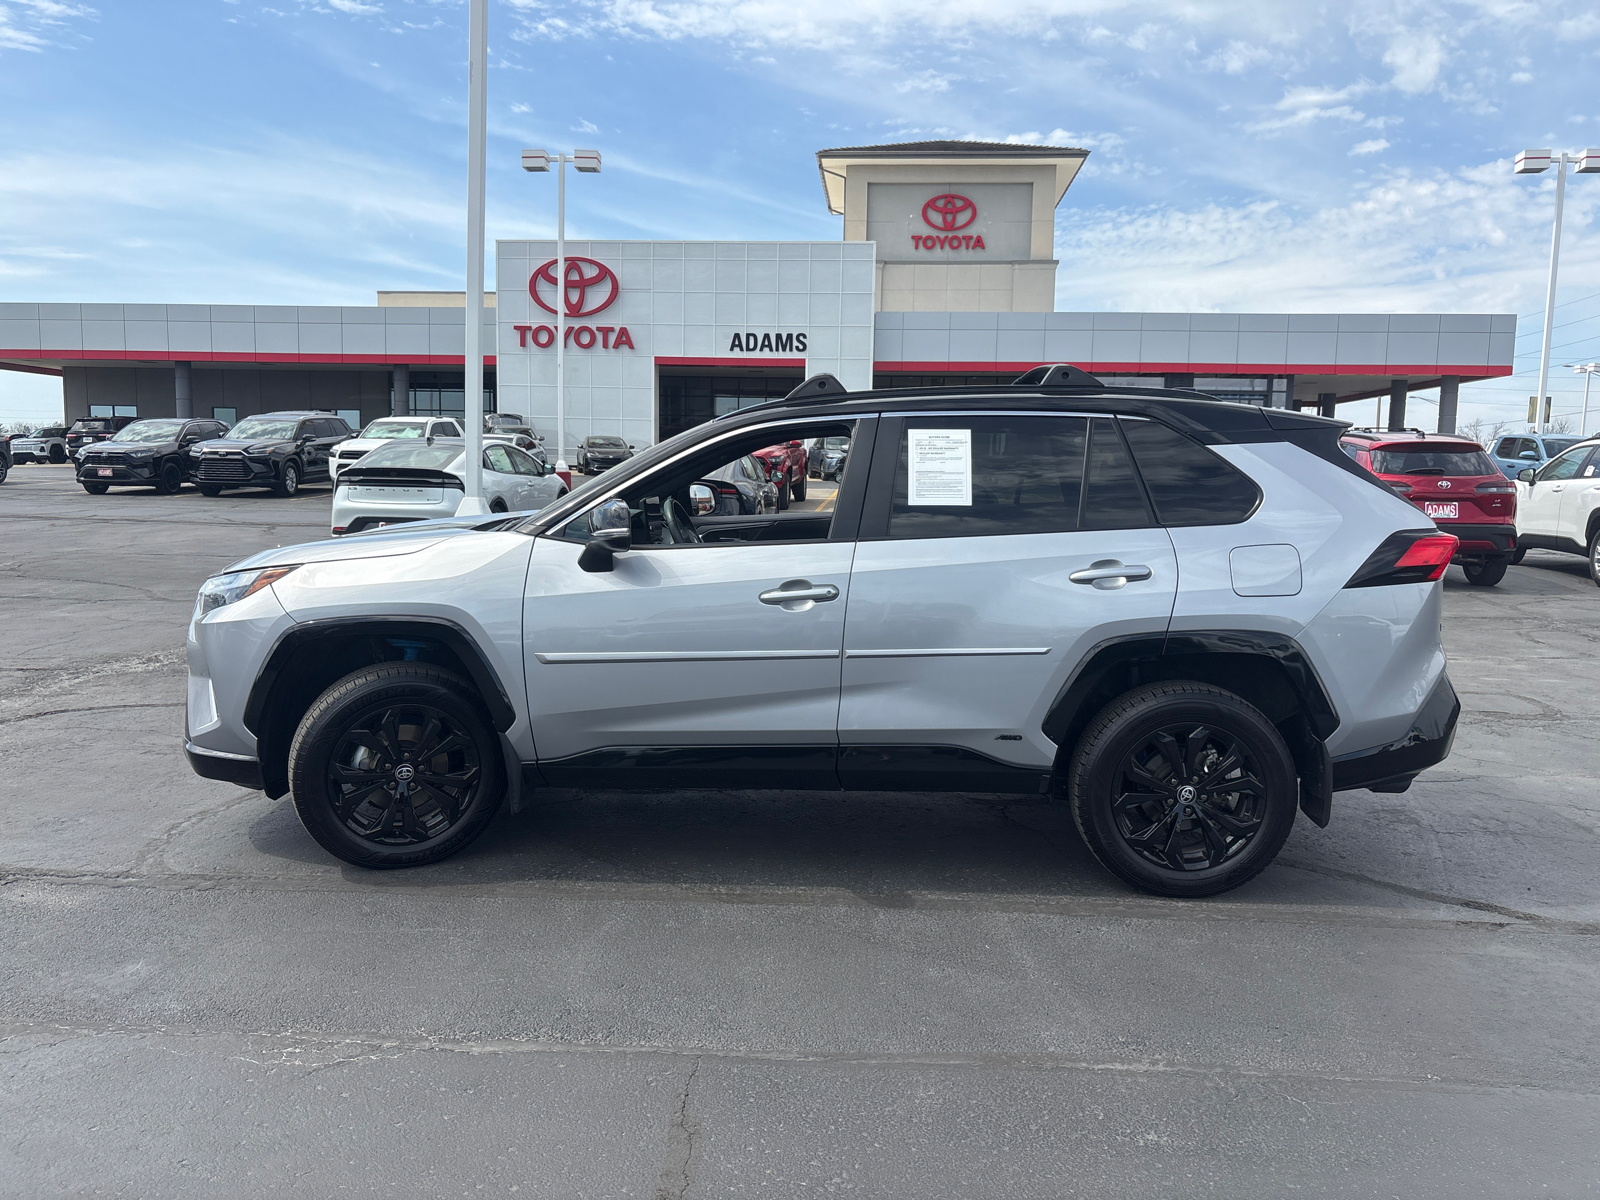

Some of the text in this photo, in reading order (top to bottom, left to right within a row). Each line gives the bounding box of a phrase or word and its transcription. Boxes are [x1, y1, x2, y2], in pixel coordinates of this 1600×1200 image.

[911, 235, 985, 250] TOYOTA
[513, 325, 635, 349] TOYOTA
[729, 333, 807, 352] ADAMS
[1427, 505, 1455, 516] ADAMS
